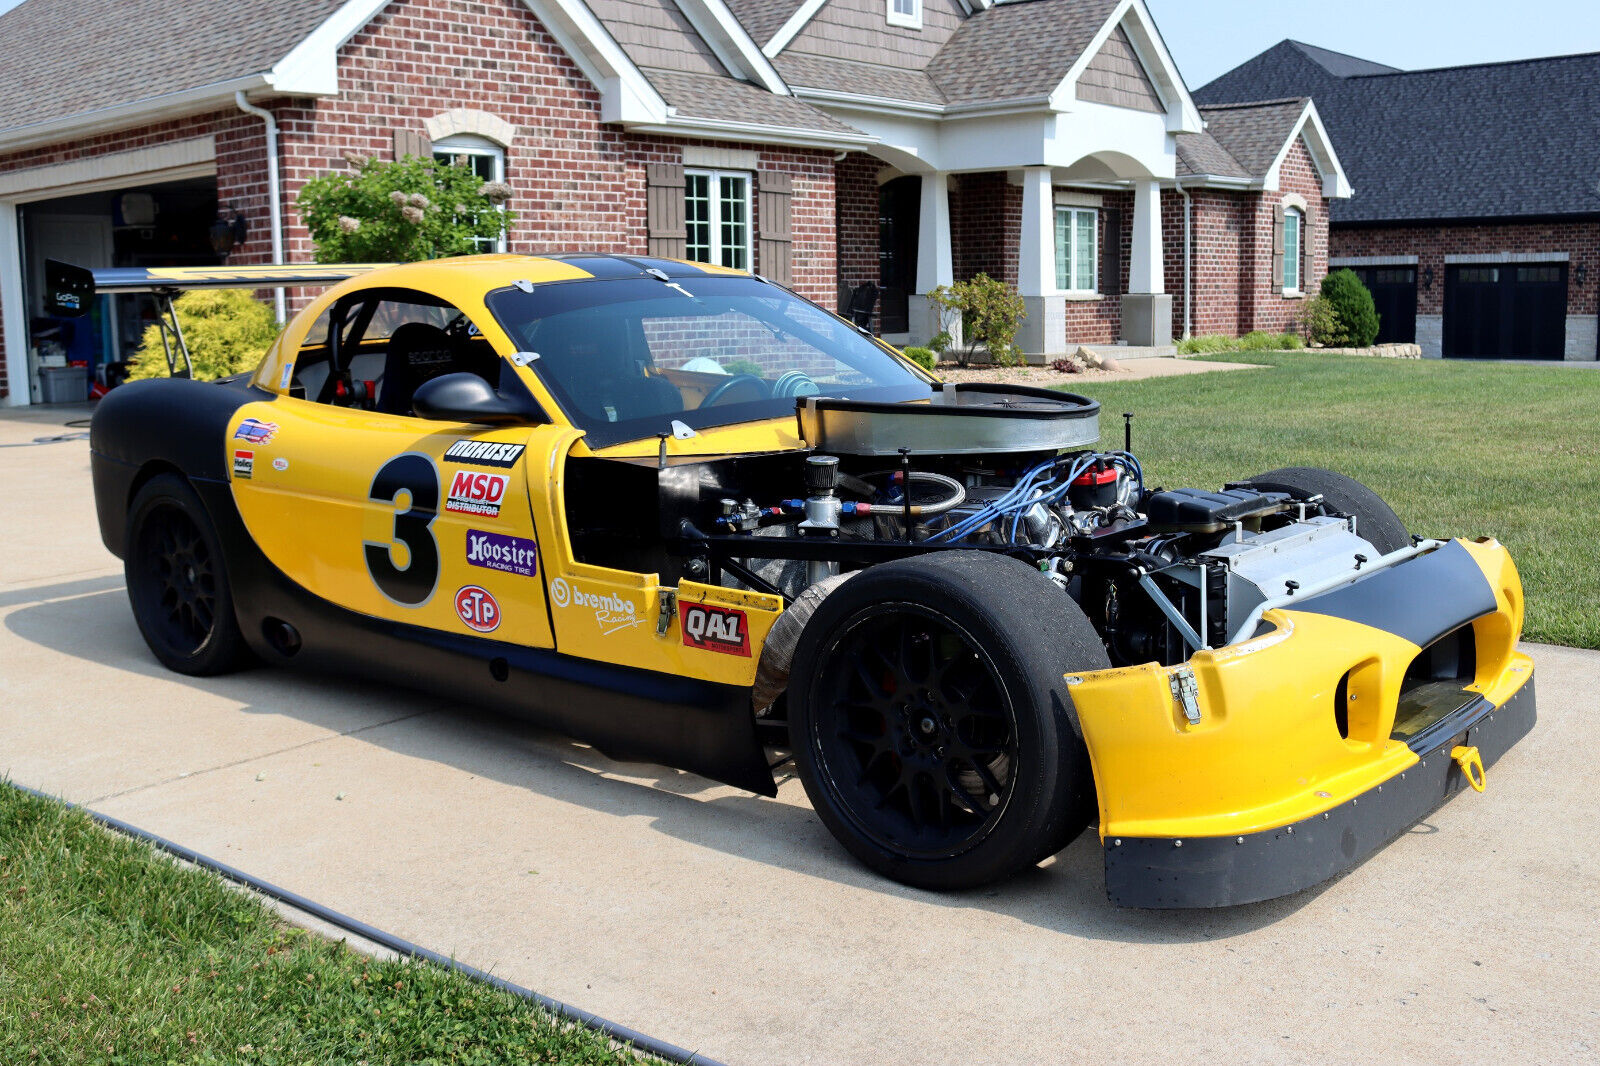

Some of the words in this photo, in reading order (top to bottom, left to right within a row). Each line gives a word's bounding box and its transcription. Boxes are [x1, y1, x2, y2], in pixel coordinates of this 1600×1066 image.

[451, 472, 505, 502] MSD
[446, 501, 499, 516] DISTRIBUTOR
[362, 451, 441, 609] 3
[467, 534, 535, 567] Hoosier
[486, 560, 513, 572] RACING
[515, 566, 532, 576] TIRE
[461, 591, 495, 624] STP
[573, 585, 635, 614] brembo
[595, 609, 642, 632] Racing
[687, 608, 743, 644] QA1
